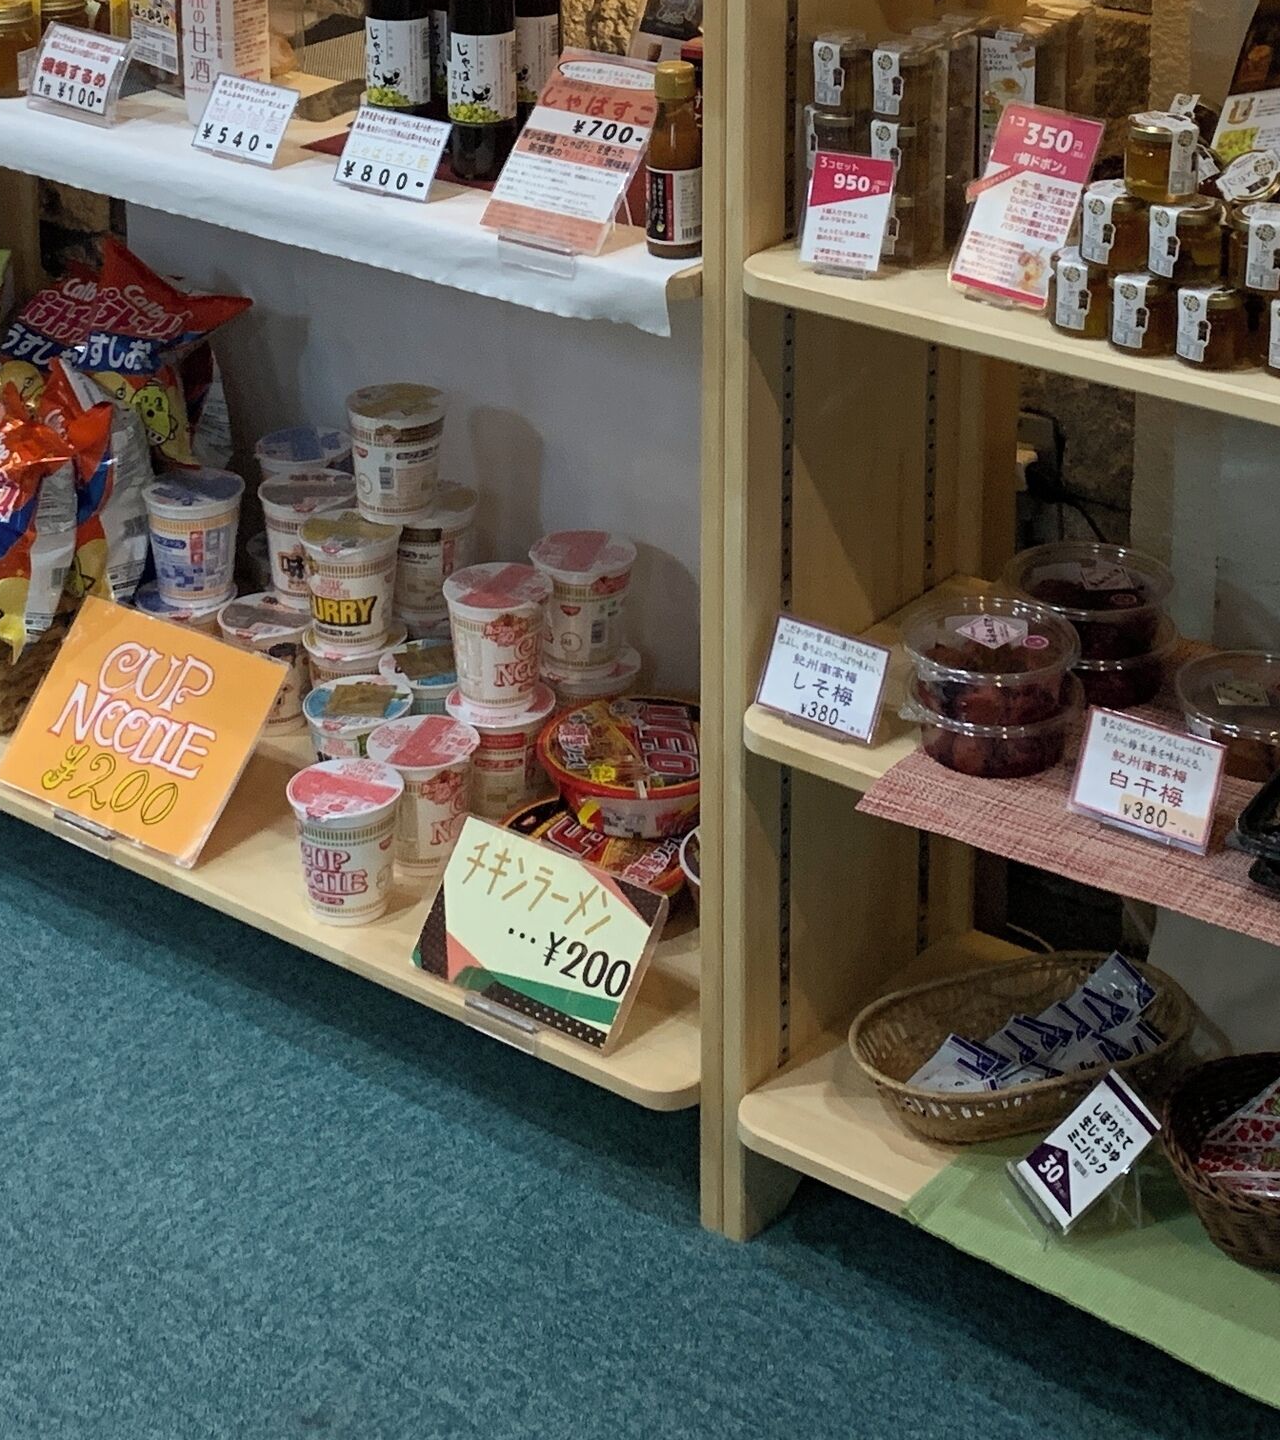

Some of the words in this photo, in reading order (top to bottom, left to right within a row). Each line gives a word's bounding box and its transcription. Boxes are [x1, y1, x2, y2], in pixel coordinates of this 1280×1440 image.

[58, 82, 102, 108] ¥100-
[542, 86, 654, 124] じゃばすこ
[202, 121, 273, 152] ¥540-
[572, 119, 643, 144] ¥700-
[344, 159, 424, 190] ¥800-
[62, 279, 97, 299] Calb
[314, 596, 378, 626] URRY
[93, 640, 215, 714] CUP
[793, 653, 857, 684] 紀州南高梅
[793, 671, 854, 706] しそ梅
[801, 701, 846, 725] ¥380-
[1112, 749, 1188, 783] 紀州南高梅
[40, 741, 182, 828] ¥200
[1110, 770, 1184, 807] 白干梅
[1124, 802, 1177, 828] ¥380-
[461, 839, 614, 936] チキンラーメン
[1093, 1102, 1134, 1150] しぼりたて
[1067, 1129, 1107, 1174] ミニパック
